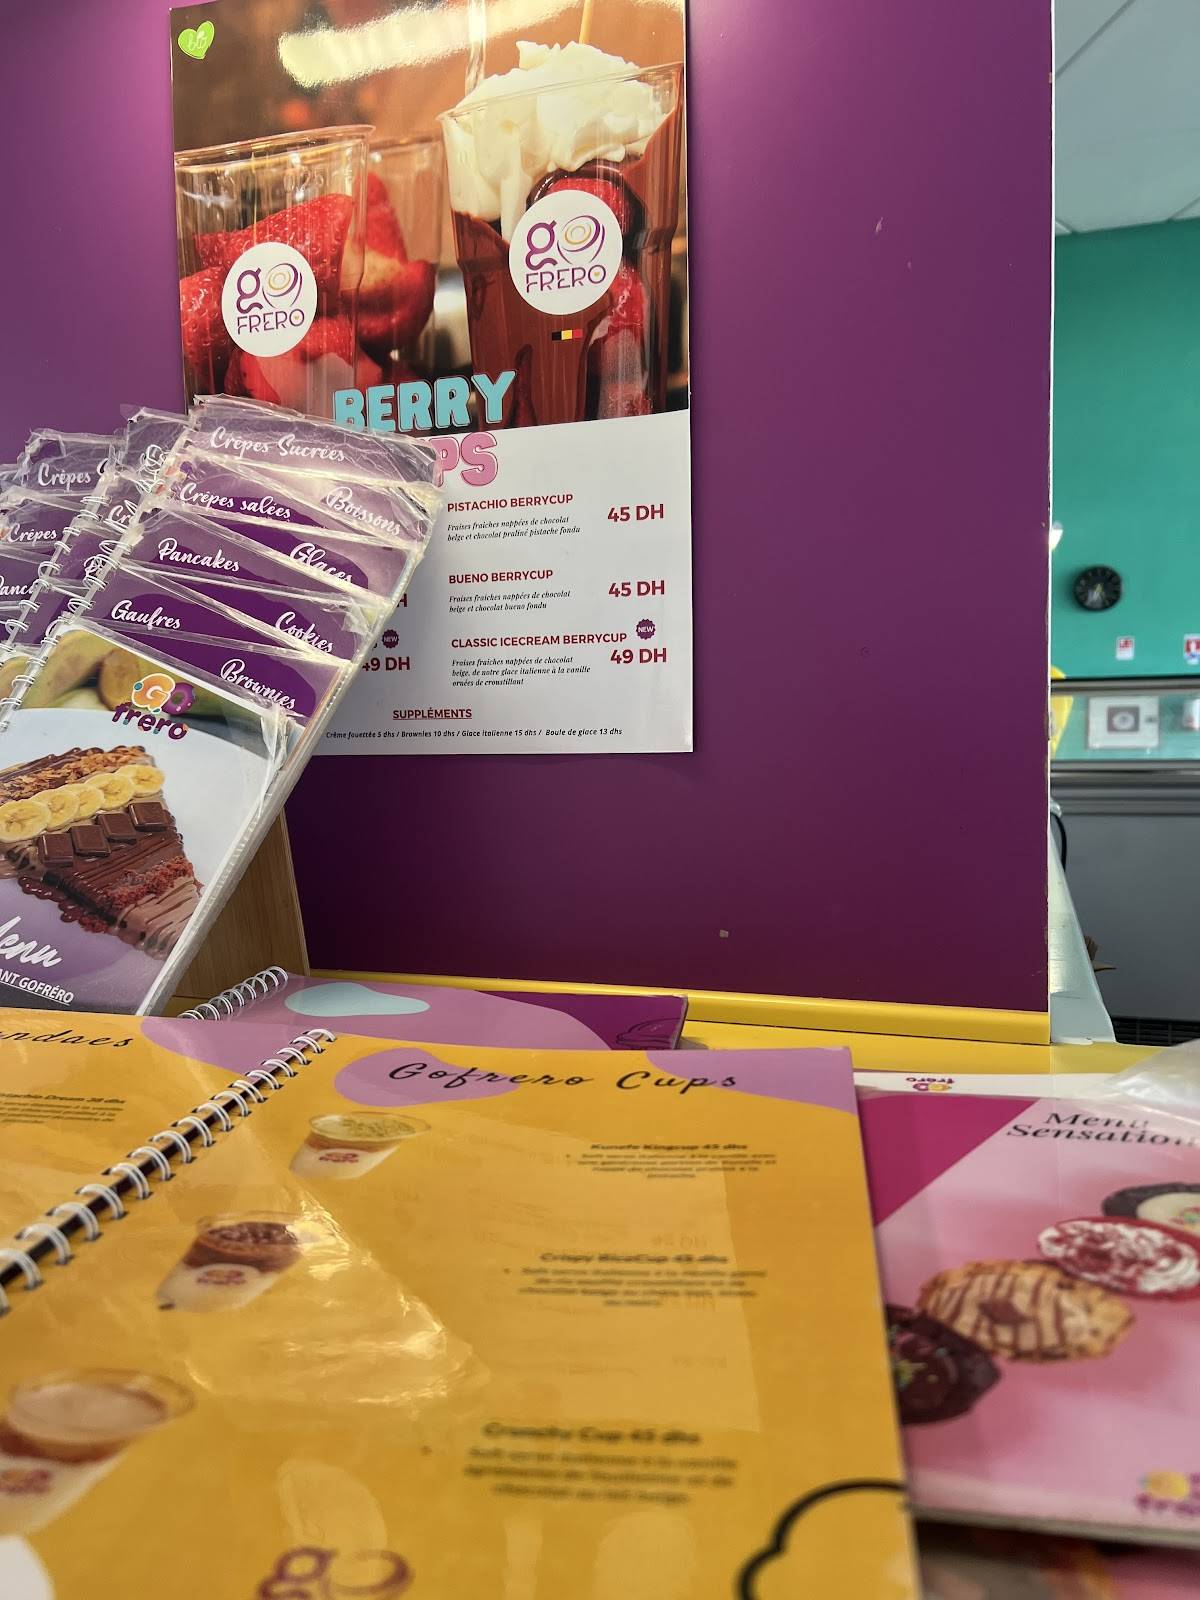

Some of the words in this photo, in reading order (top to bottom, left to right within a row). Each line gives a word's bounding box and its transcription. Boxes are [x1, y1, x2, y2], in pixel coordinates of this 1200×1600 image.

[525, 264, 607, 293] FRERO
[236, 308, 305, 335] FRERO
[333, 371, 516, 432] BERRY
[209, 426, 269, 458] Crêpes
[277, 433, 346, 463] Sucrées
[432, 431, 498, 487] PS
[38, 462, 92, 491] Crêpes
[179, 481, 234, 516] Crêpes
[240, 495, 291, 520] salées
[447, 499, 508, 512] PISTACHIO
[510, 494, 574, 507] BERRYCUP
[326, 486, 401, 537] Boissons
[607, 506, 631, 523] 45
[636, 504, 665, 521] DH
[447, 524, 471, 532] Fraises
[530, 517, 539, 526] de
[540, 515, 570, 525] chocolat
[465, 532, 473, 540] et
[473, 530, 502, 540] chocolat
[529, 527, 559, 538] pistache
[559, 525, 581, 535] fondu
[8, 524, 57, 546] Crêpes
[157, 538, 241, 573] Pancakes
[289, 542, 354, 584] Glaces
[448, 573, 489, 584] BUENO
[491, 569, 554, 582] BERRYCUP
[449, 595, 473, 603] Fraises
[531, 591, 541, 599] de
[541, 590, 571, 599] chocolat
[608, 581, 632, 598] 45
[636, 580, 666, 596] DH
[111, 600, 182, 631] Gaufres
[475, 603, 503, 612] chocolat
[504, 602, 526, 611] bueno
[526, 601, 547, 611] fondu
[275, 611, 333, 654] Cookies
[451, 637, 498, 649] CLASSIC
[500, 635, 560, 647] ICECREAM
[562, 633, 627, 645] BERRYCUP
[385, 656, 411, 671] DH
[534, 656, 543, 665] de
[543, 655, 574, 664] chocolat
[610, 649, 634, 664] 49
[639, 647, 667, 664] DH
[481, 669, 500, 677] notre
[519, 667, 551, 676] italienne
[557, 666, 565, 674] la
[566, 665, 591, 674] vanille
[220, 658, 297, 711] Brownies
[452, 679, 474, 687] ornées
[475, 679, 484, 687] de
[484, 678, 524, 687] croustillant
[392, 707, 473, 719] SUPPLÉMENTS
[347, 731, 376, 740] fouettée
[383, 730, 395, 738] dhs
[482, 729, 513, 737] italienne
[514, 729, 523, 737] 15
[524, 729, 537, 737] dhs
[567, 728, 577, 736] de
[599, 728, 608, 736] 13
[609, 728, 623, 736] dhs
[18, 977, 75, 1004] GOFRÉRO
[388, 1062, 595, 1089] Gofrero
[615, 1070, 738, 1094] Cups
